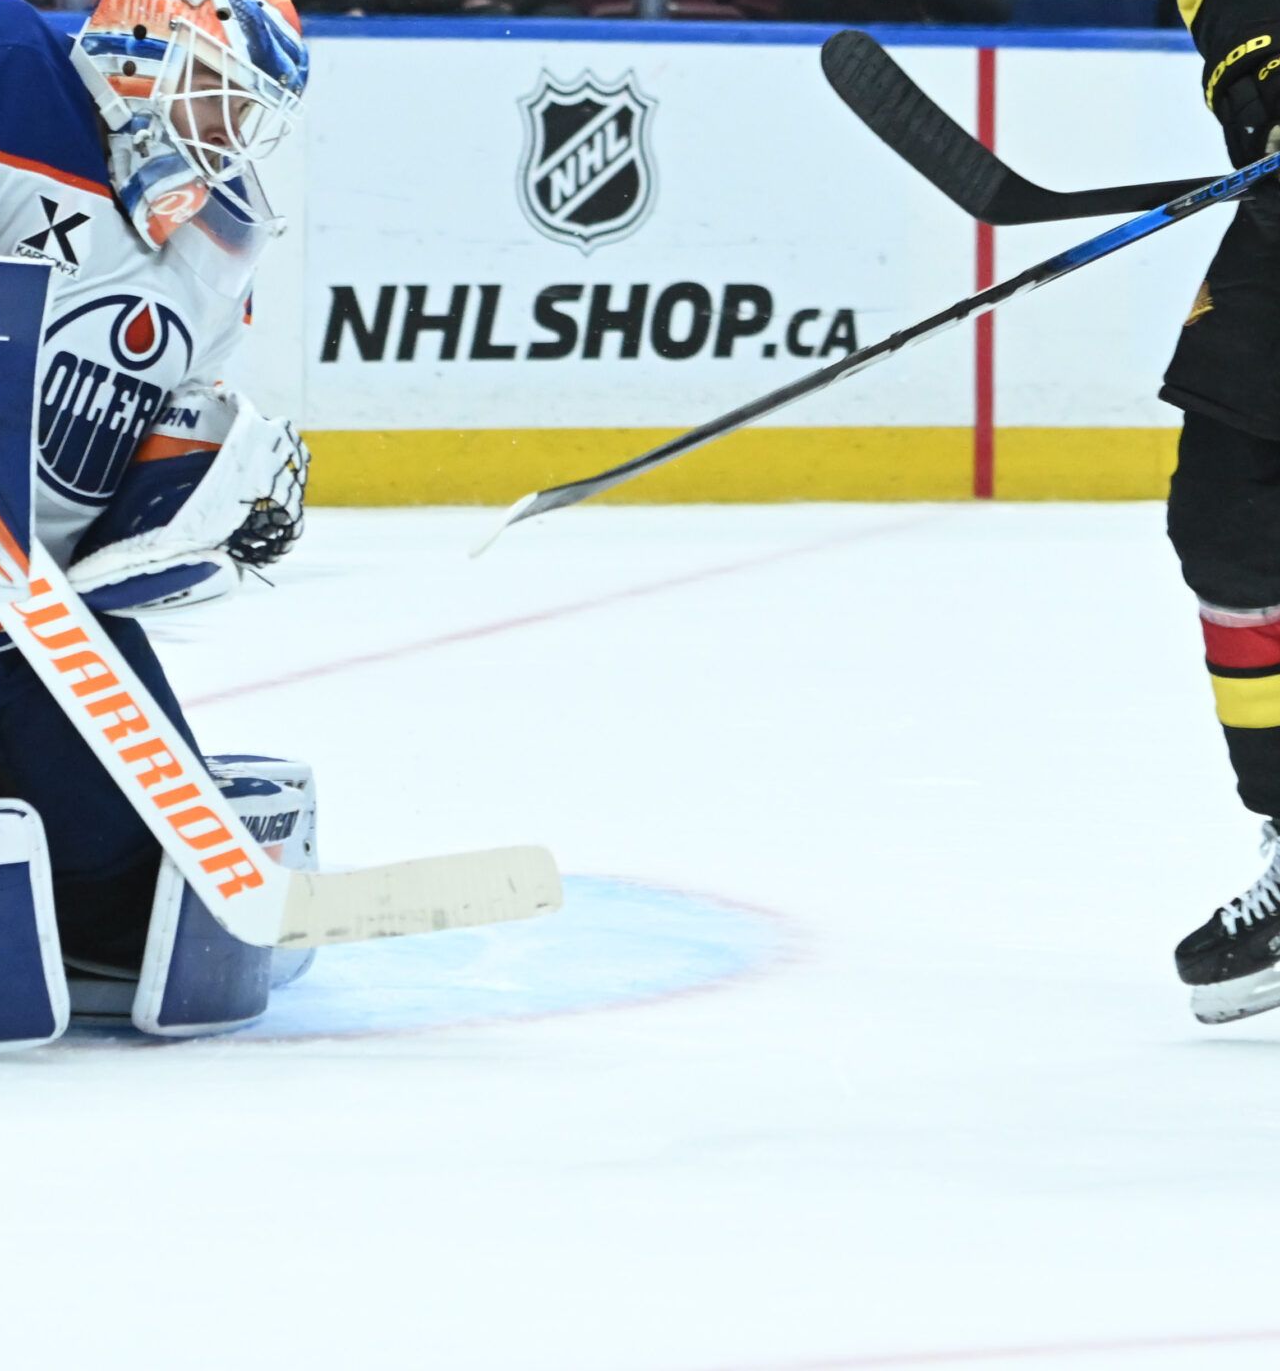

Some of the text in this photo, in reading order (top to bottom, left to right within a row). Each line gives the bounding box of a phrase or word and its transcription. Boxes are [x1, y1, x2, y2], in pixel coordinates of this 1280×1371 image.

[550, 119, 630, 211] NHL
[320, 281, 861, 363] NHLSHOP.CA
[37, 350, 168, 458] OILER
[10, 577, 265, 901] WARRIOR
